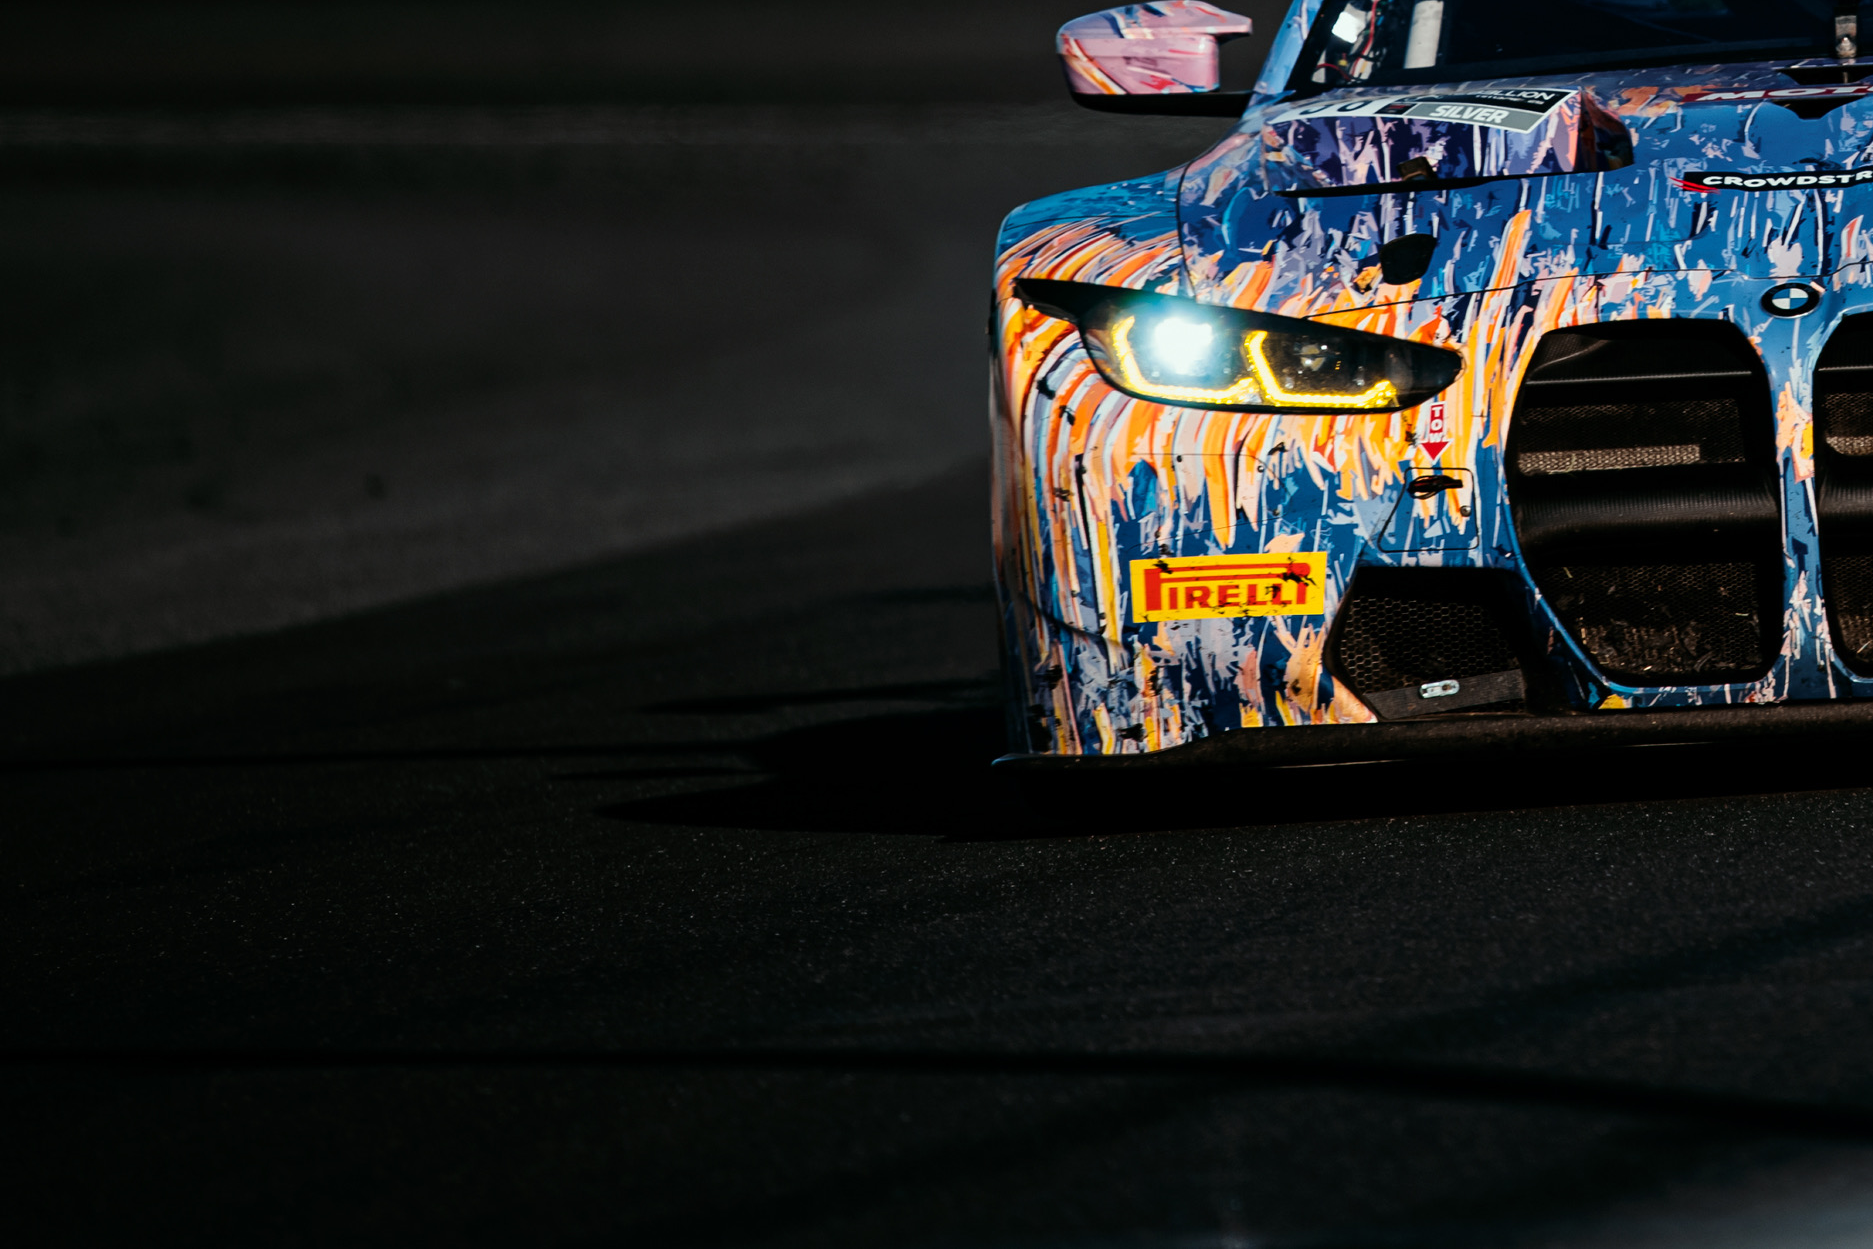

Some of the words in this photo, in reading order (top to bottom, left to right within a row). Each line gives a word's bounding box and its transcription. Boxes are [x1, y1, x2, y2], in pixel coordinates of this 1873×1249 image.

[1429, 105, 1511, 124] SILVER
[1429, 406, 1444, 443] TOW
[1144, 562, 1311, 611] PIRELLI
